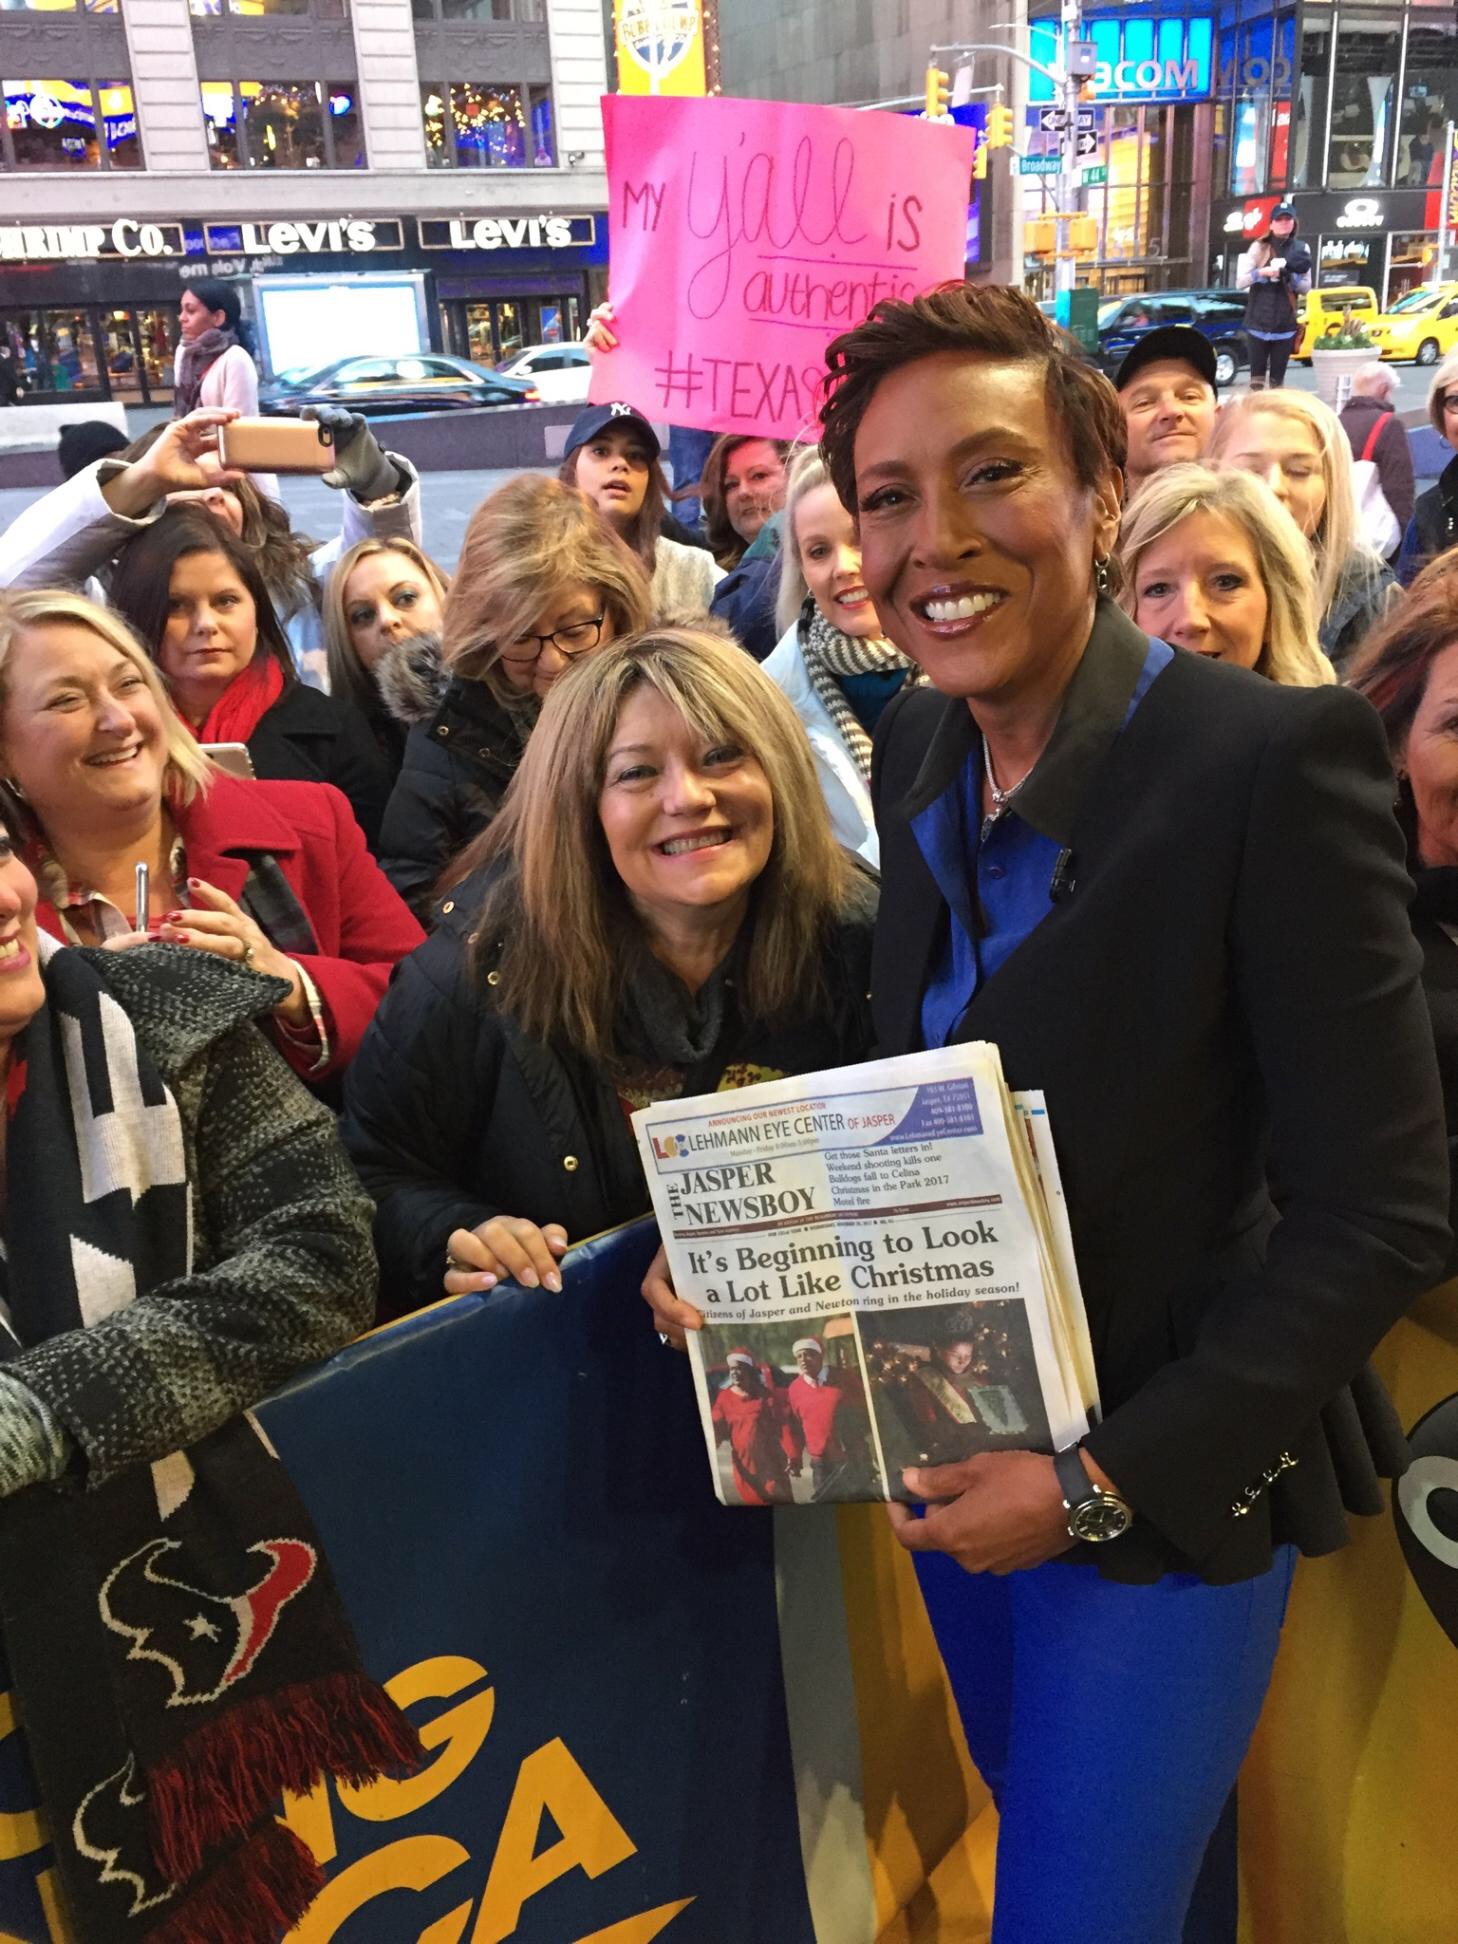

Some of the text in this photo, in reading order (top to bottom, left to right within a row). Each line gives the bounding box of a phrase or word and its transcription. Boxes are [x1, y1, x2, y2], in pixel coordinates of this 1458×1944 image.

[1021, 158, 1060, 174] Broadway
[0, 225, 105, 258] HRIMP
[111, 218, 174, 257] Co.
[622, 181, 666, 231] MY
[687, 132, 867, 320] y'all
[743, 269, 917, 321] authentic
[688, 1112, 896, 1152] LEHMANN EYE CENTER OF JASPER
[708, 1114, 753, 1128] ANNOUNCING
[753, 1110, 769, 1121] OUR
[769, 1106, 796, 1118] NEWEST
[824, 1142, 933, 1161] Get those Santa letters in!
[826, 1154, 942, 1173] Weekend shooting kills one
[681, 1161, 776, 1195] JASPER
[828, 1169, 921, 1185] Bulldogs fall to Celina
[831, 1174, 950, 1196] Christmas in the Park 2017
[667, 1182, 684, 1221] THE
[685, 1186, 816, 1226] NEWSBOY
[833, 1196, 871, 1207] Motel fire
[688, 1219, 1000, 1274] It's Beginning to Look
[706, 1259, 995, 1304] a Lot Like Christmas
[736, 1308, 747, 1320] of
[750, 1307, 787, 1321] Jasper
[788, 1303, 812, 1315] and
[815, 1298, 860, 1312] Newton
[862, 1295, 885, 1308] ring
[887, 1294, 900, 1304] in
[903, 1291, 923, 1303] the
[926, 1287, 971, 1300] holiday
[975, 1281, 1021, 1296] season!
